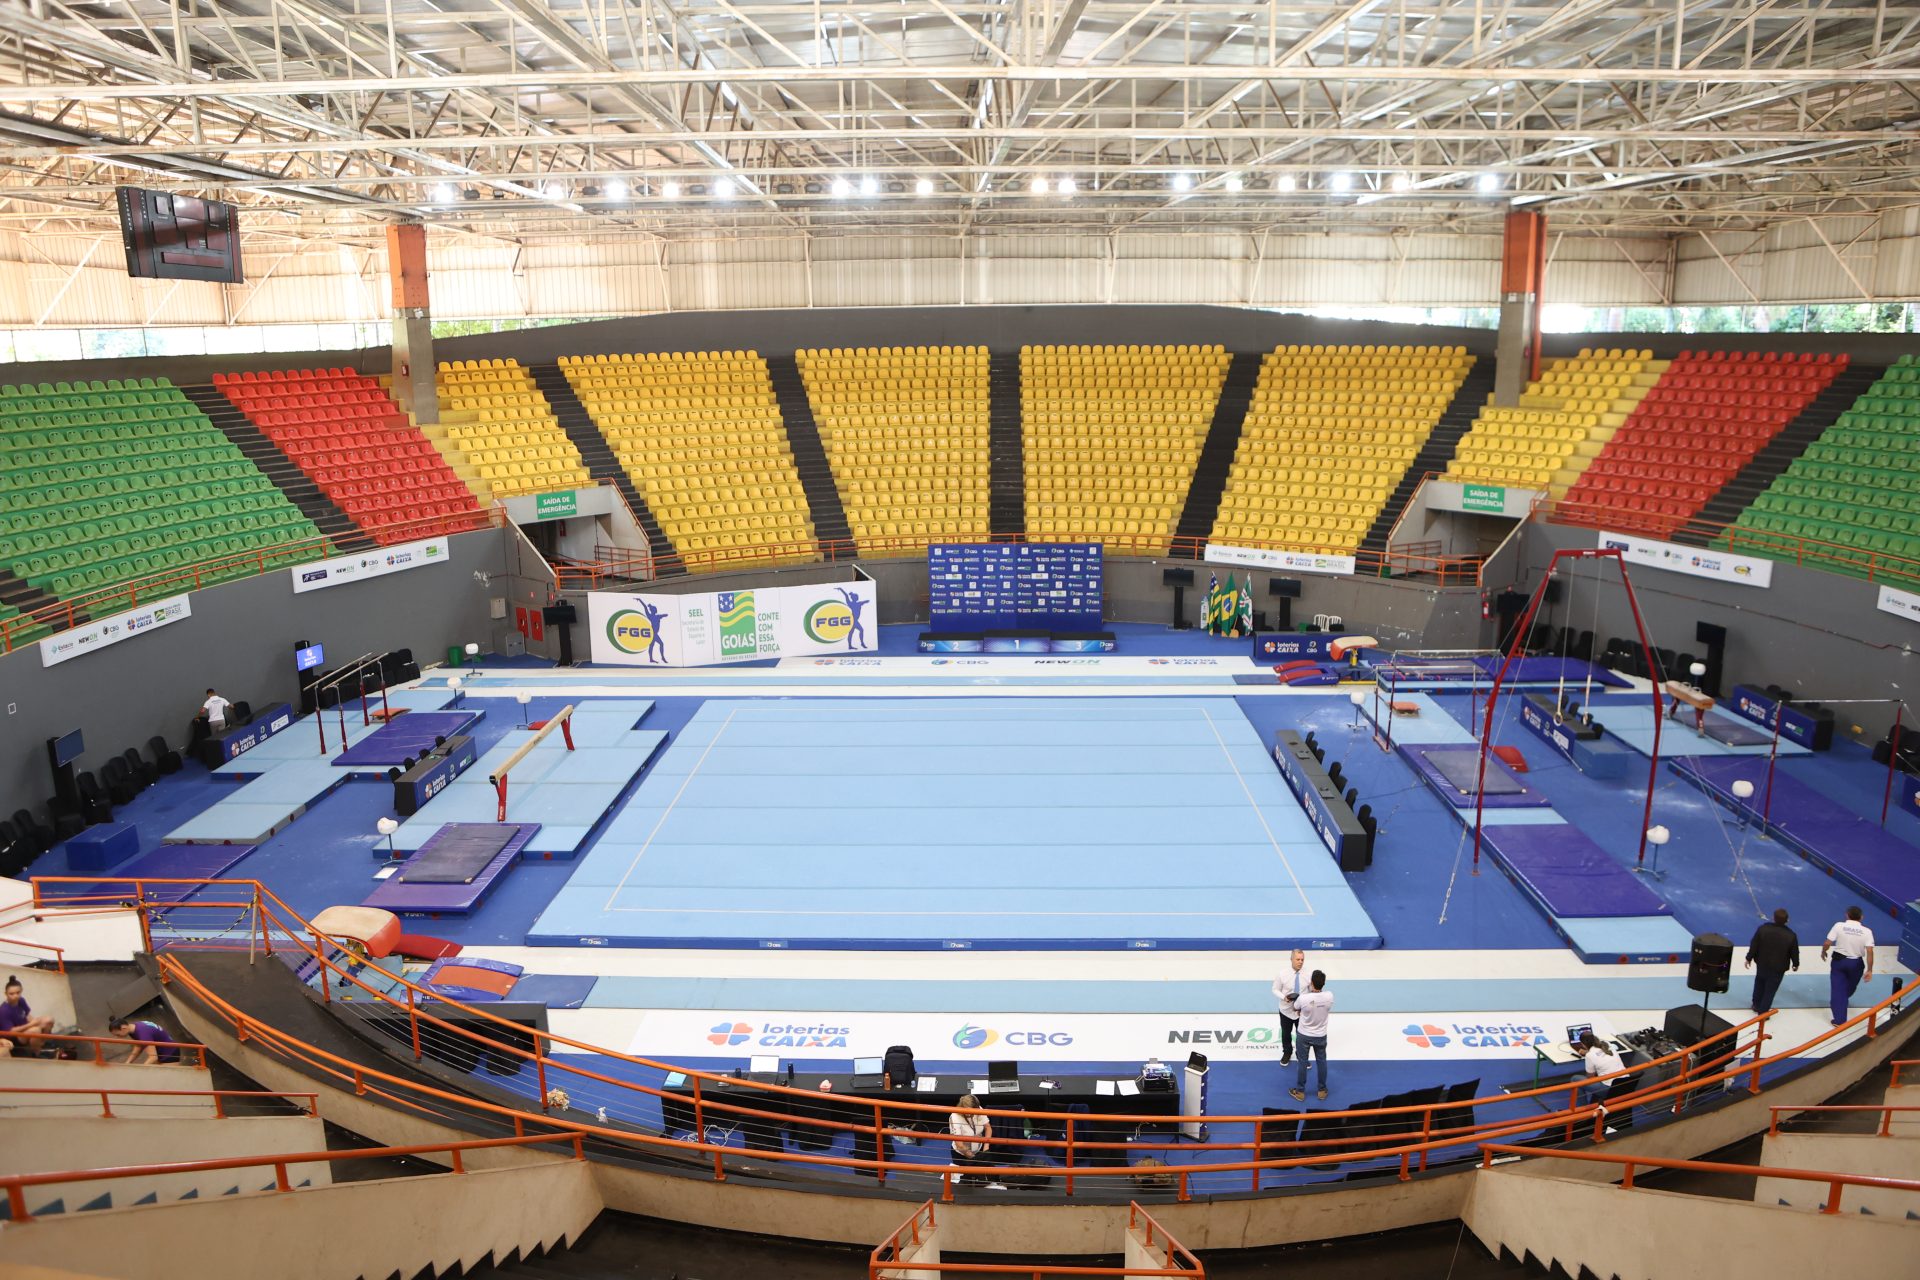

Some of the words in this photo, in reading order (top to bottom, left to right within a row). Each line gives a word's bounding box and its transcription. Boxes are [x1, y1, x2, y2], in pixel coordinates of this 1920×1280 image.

[543, 497, 561, 505] SAÍDA
[1463, 497, 1504, 507] EMERGÊNCIA
[538, 504, 576, 514] EMERGÊNCIA
[688, 608, 704, 618] SEEL
[757, 611, 779, 622] CONTE
[136, 619, 153, 628] CAIXA
[815, 616, 851, 628] FGG
[617, 626, 651, 638] FGG
[758, 623, 773, 632] COM
[759, 633, 775, 642] ESSA
[759, 644, 781, 653] FORÇA
[952, 641, 960, 650] 2
[1014, 640, 1020, 650] 1
[1075, 642, 1082, 650] 3
[762, 1023, 850, 1035] loterias
[1452, 1023, 1544, 1035] loterias
[759, 1035, 847, 1048] CAIXA
[1005, 1032, 1073, 1047] CBG
[1462, 1035, 1551, 1047] CAIXA
